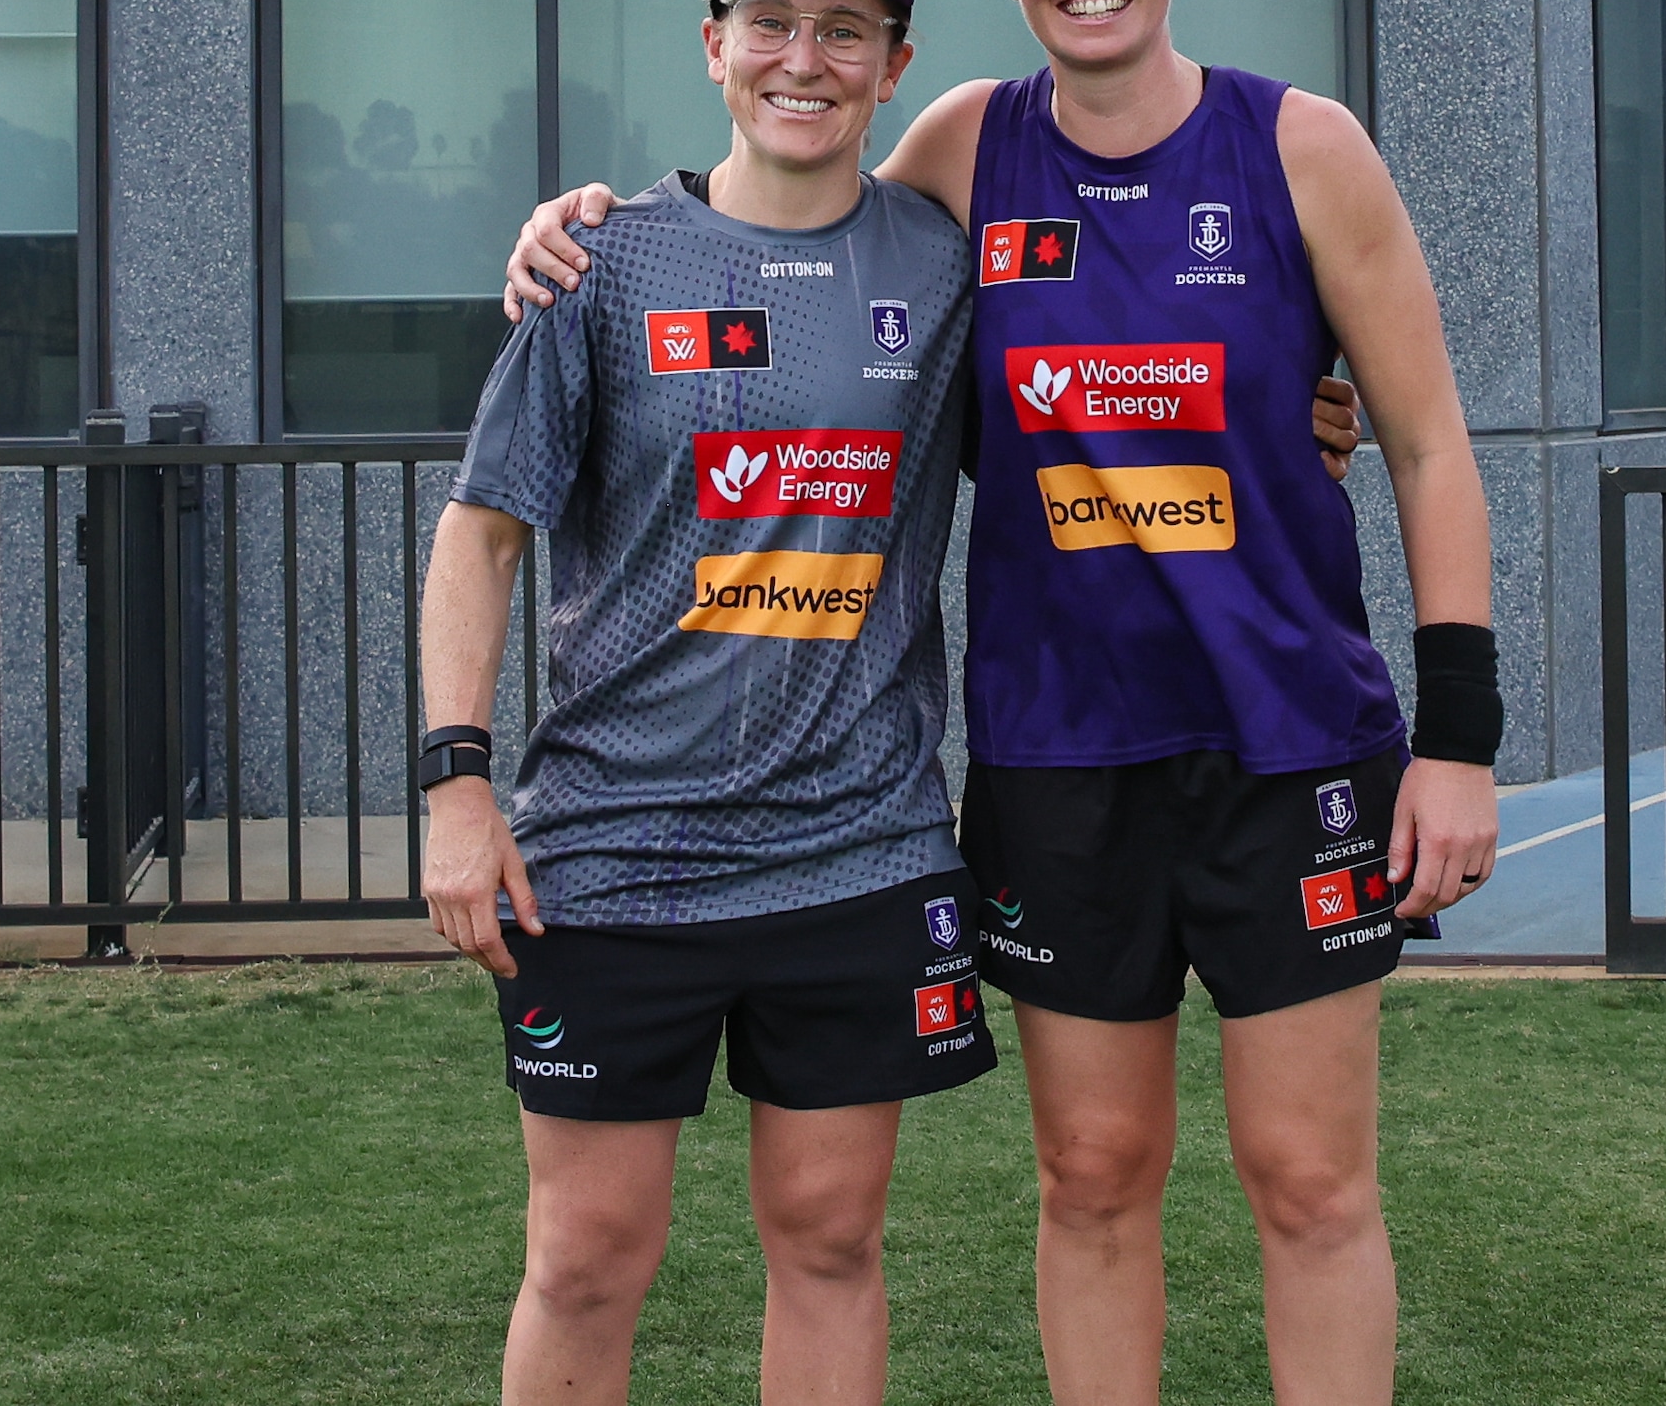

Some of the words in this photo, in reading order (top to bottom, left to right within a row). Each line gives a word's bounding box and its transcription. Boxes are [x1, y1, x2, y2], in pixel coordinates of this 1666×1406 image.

[1077, 183, 1149, 202] COTTON:ON
[760, 261, 834, 278] COTTON:ON
[1175, 273, 1247, 285] DOCKERS
[666, 325, 690, 335] AFL
[862, 367, 920, 381] DOCKERS
[1078, 357, 1209, 385] Woodside
[1085, 390, 1181, 421] Energy
[775, 443, 891, 471] Woodside
[778, 475, 867, 509] Energy
[1314, 839, 1376, 864] DOCKERS
[1319, 884, 1338, 895] AFL
[1322, 920, 1393, 952] COTTON:ON
[990, 934, 1054, 963] WORLD
[925, 956, 973, 977] DOCKERS
[523, 1060, 598, 1079] WORLD
